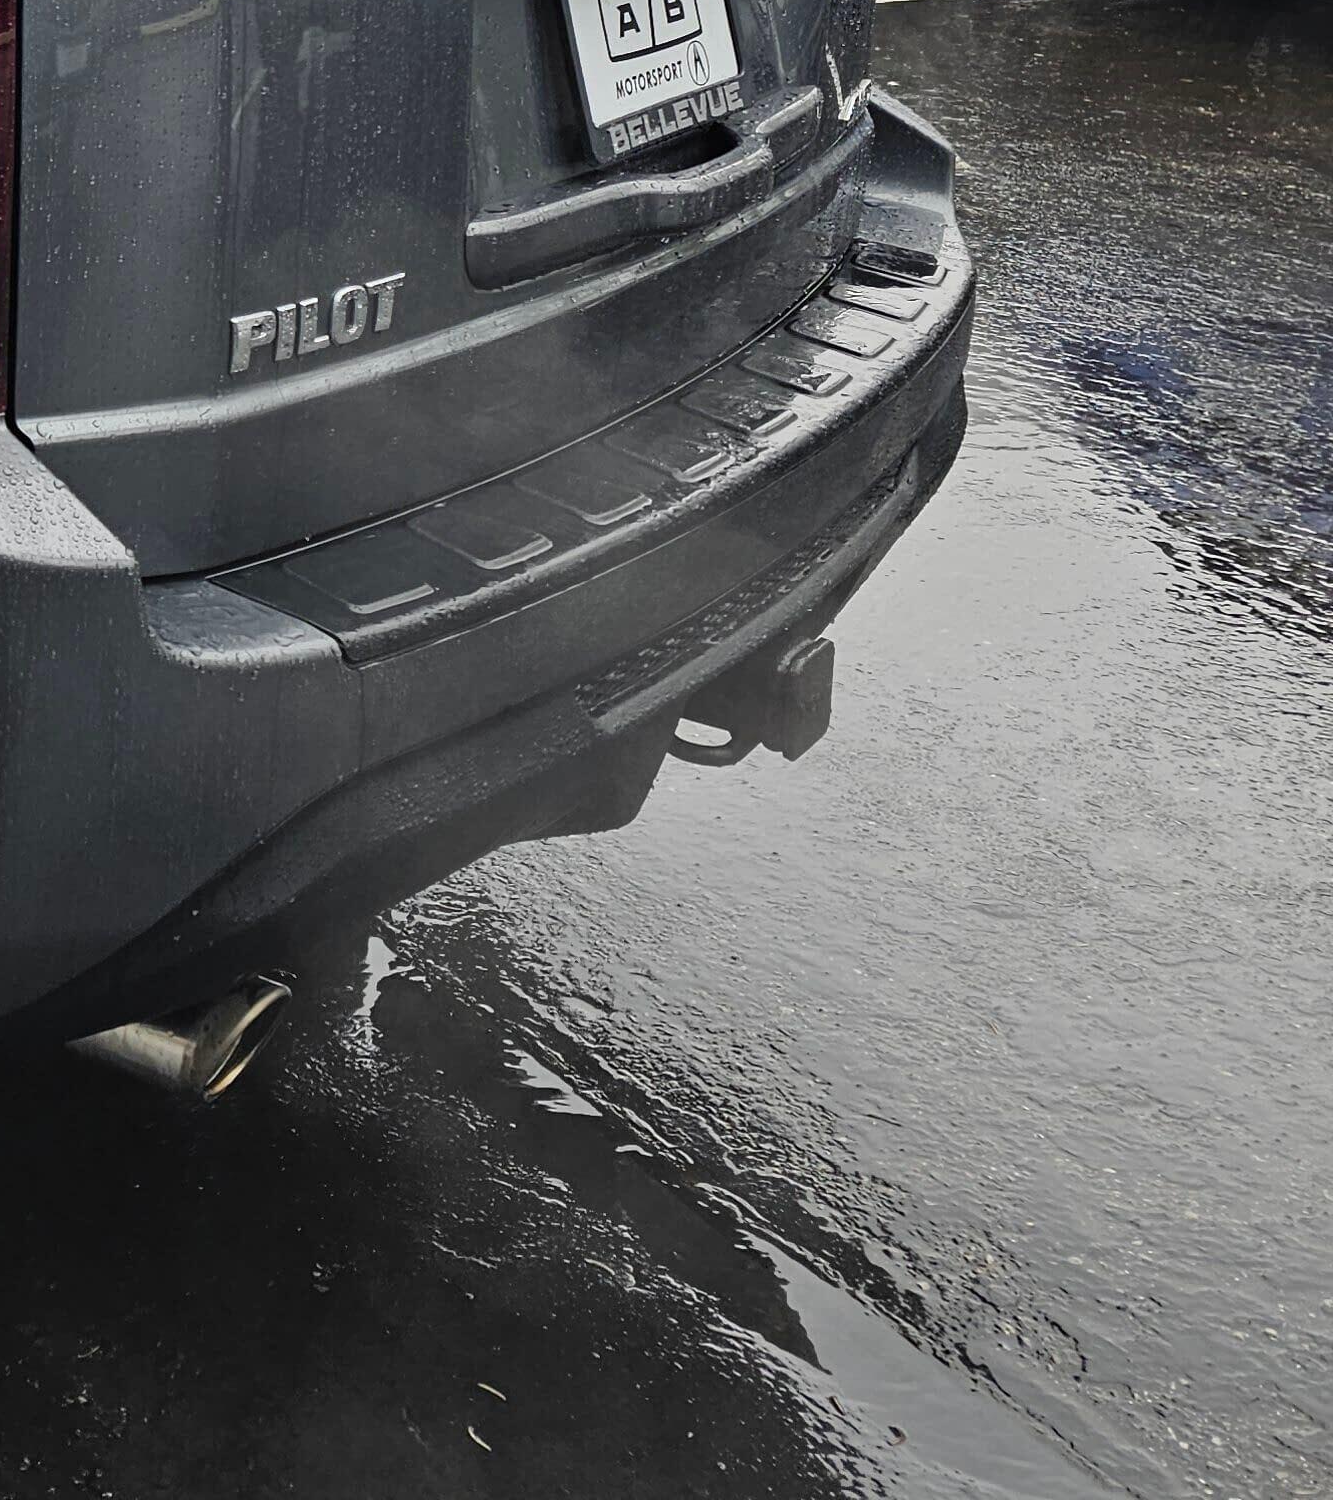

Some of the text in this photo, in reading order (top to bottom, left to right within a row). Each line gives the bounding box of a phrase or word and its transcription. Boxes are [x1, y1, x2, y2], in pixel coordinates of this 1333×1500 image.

[617, 2, 641, 38] A
[615, 60, 683, 100] MOTORSPORT
[605, 81, 744, 155] BELLEVUE
[229, 272, 406, 374] PILOT
